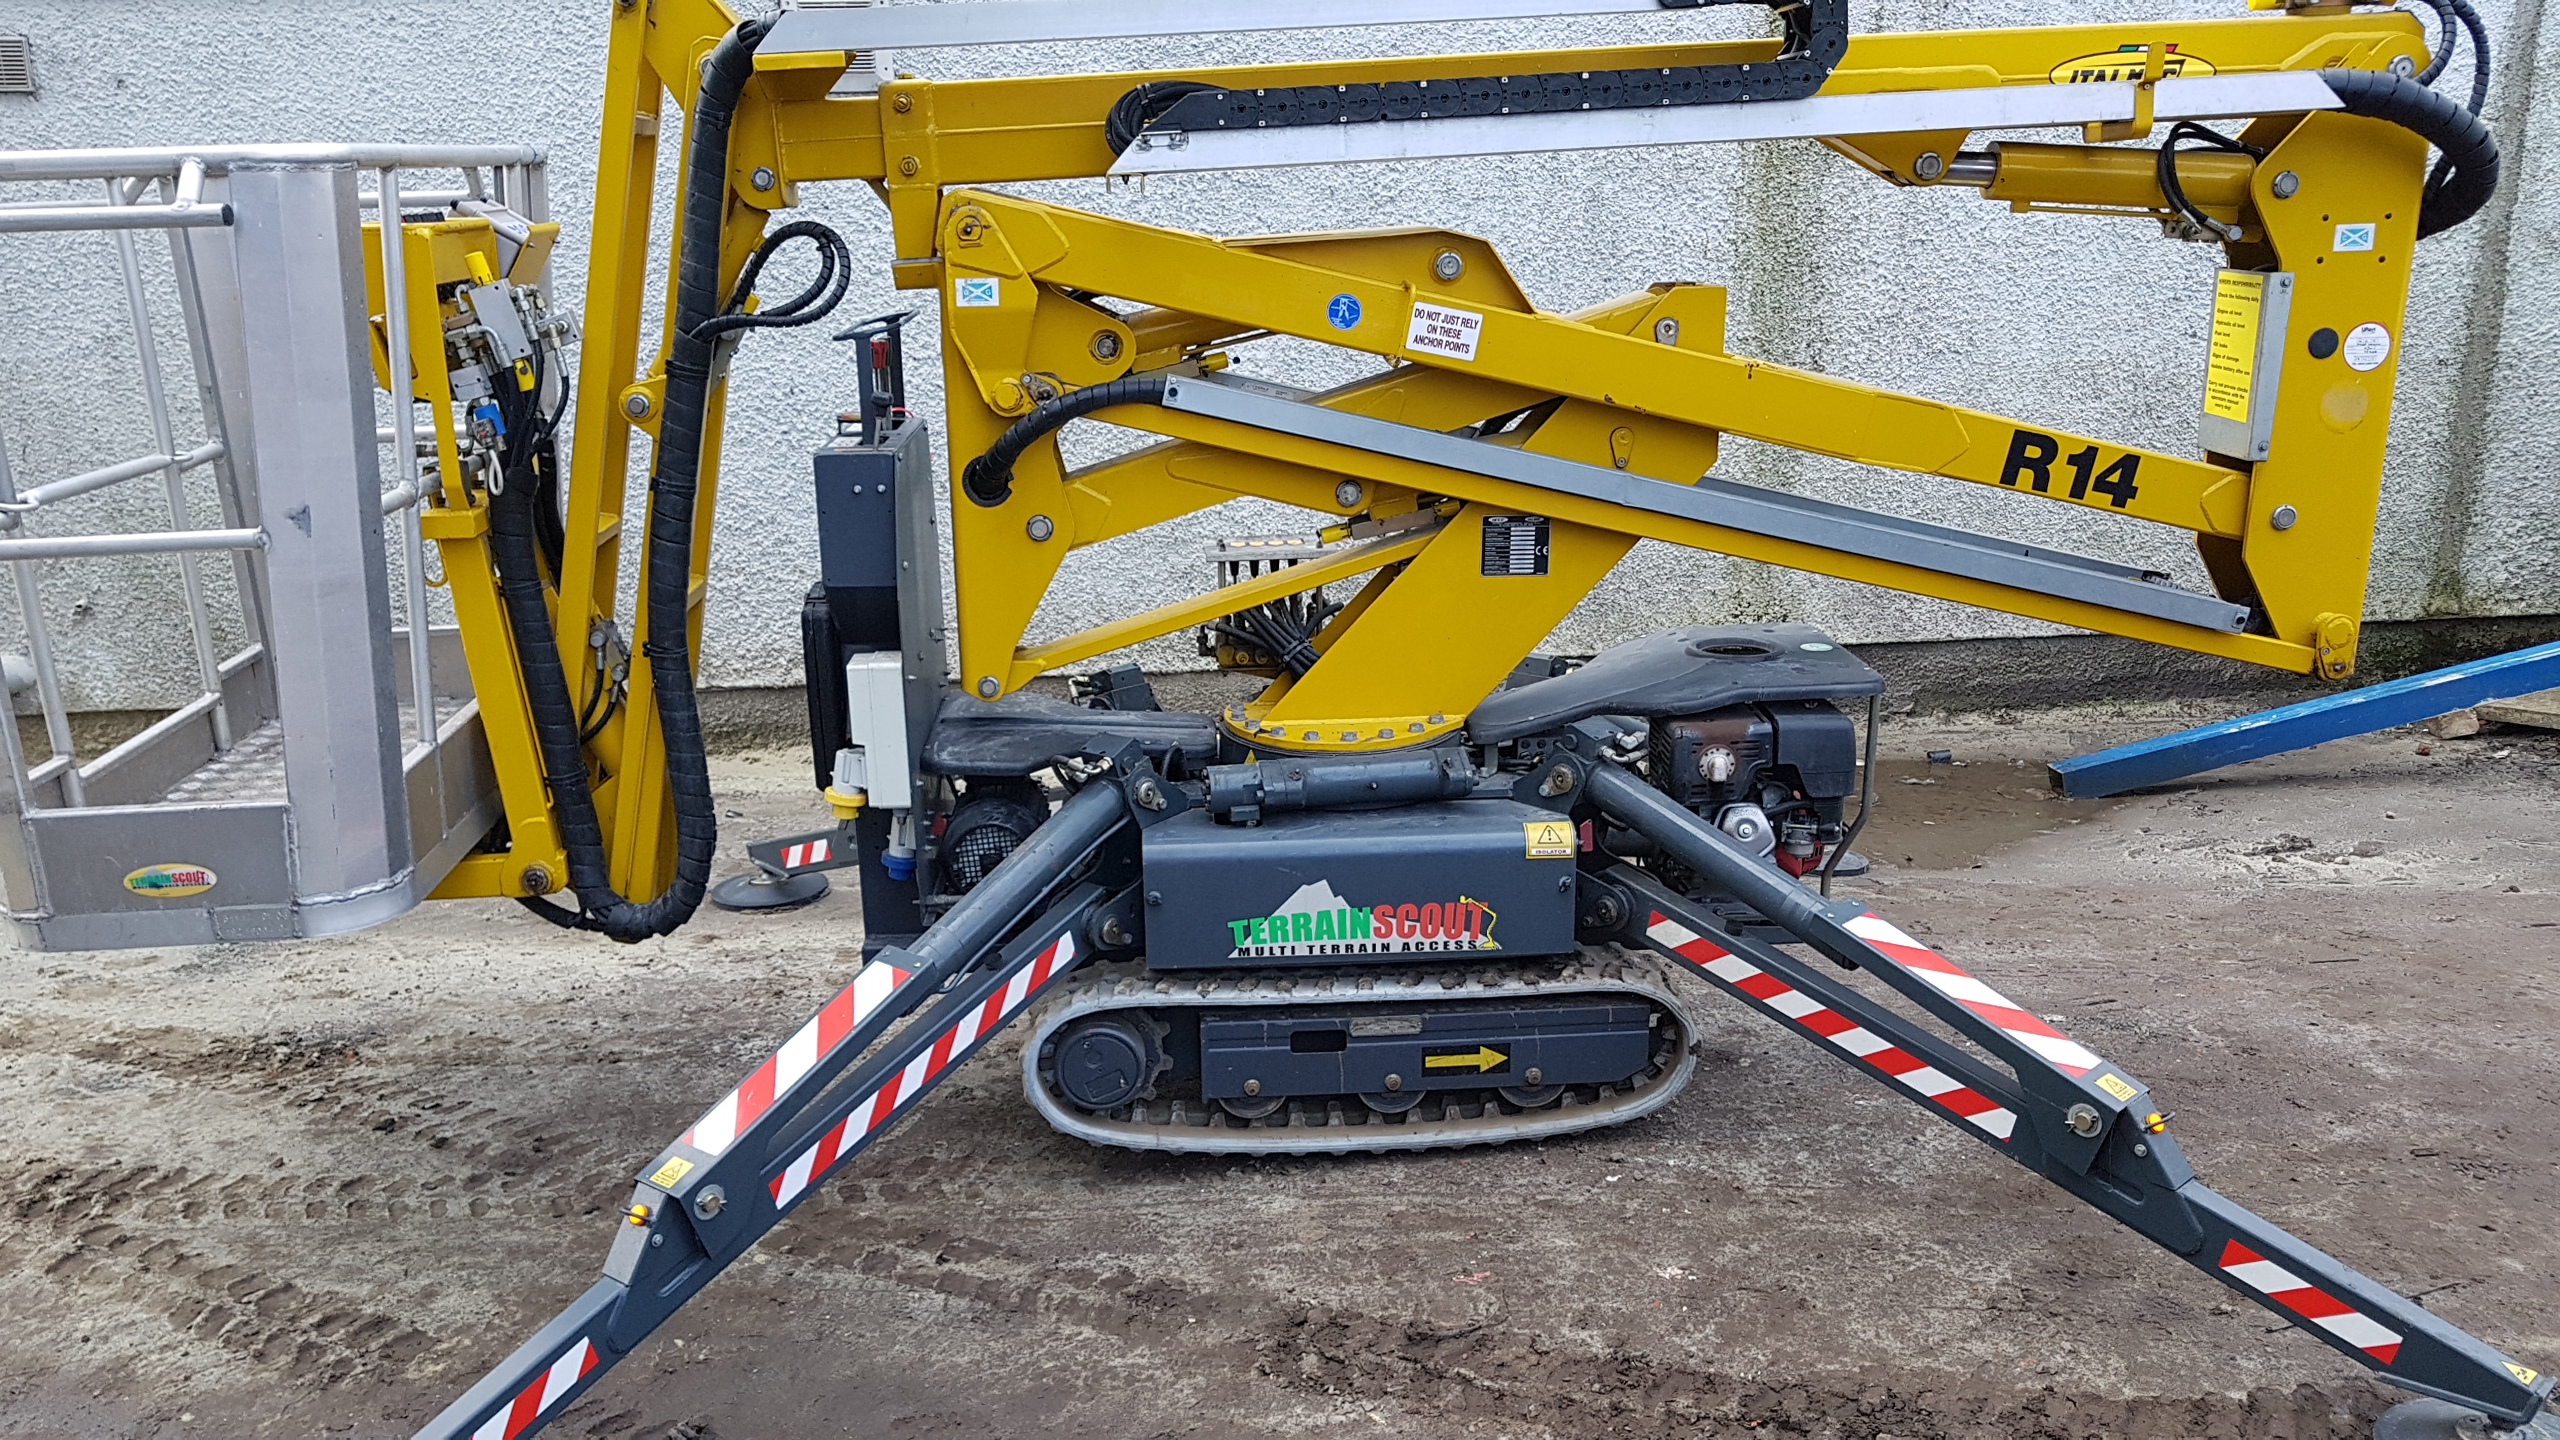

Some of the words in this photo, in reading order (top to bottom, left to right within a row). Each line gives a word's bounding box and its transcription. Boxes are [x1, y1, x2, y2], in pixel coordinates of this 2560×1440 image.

[2069, 69, 2177, 84] ITALMC
[1414, 308, 1425, 319] DO
[1426, 310, 1441, 323] NOT
[1441, 314, 1460, 326] JUST
[1461, 317, 1479, 330] RELY
[1427, 324, 1438, 335] ON
[1439, 326, 1462, 340] THESE
[1413, 334, 1443, 349] ANCHOR
[1444, 340, 1470, 354] POINTS
[1238, 945, 1295, 957] MULTI
[1307, 942, 1390, 955] TERRAIN
[1402, 940, 1478, 952] ACCESS
